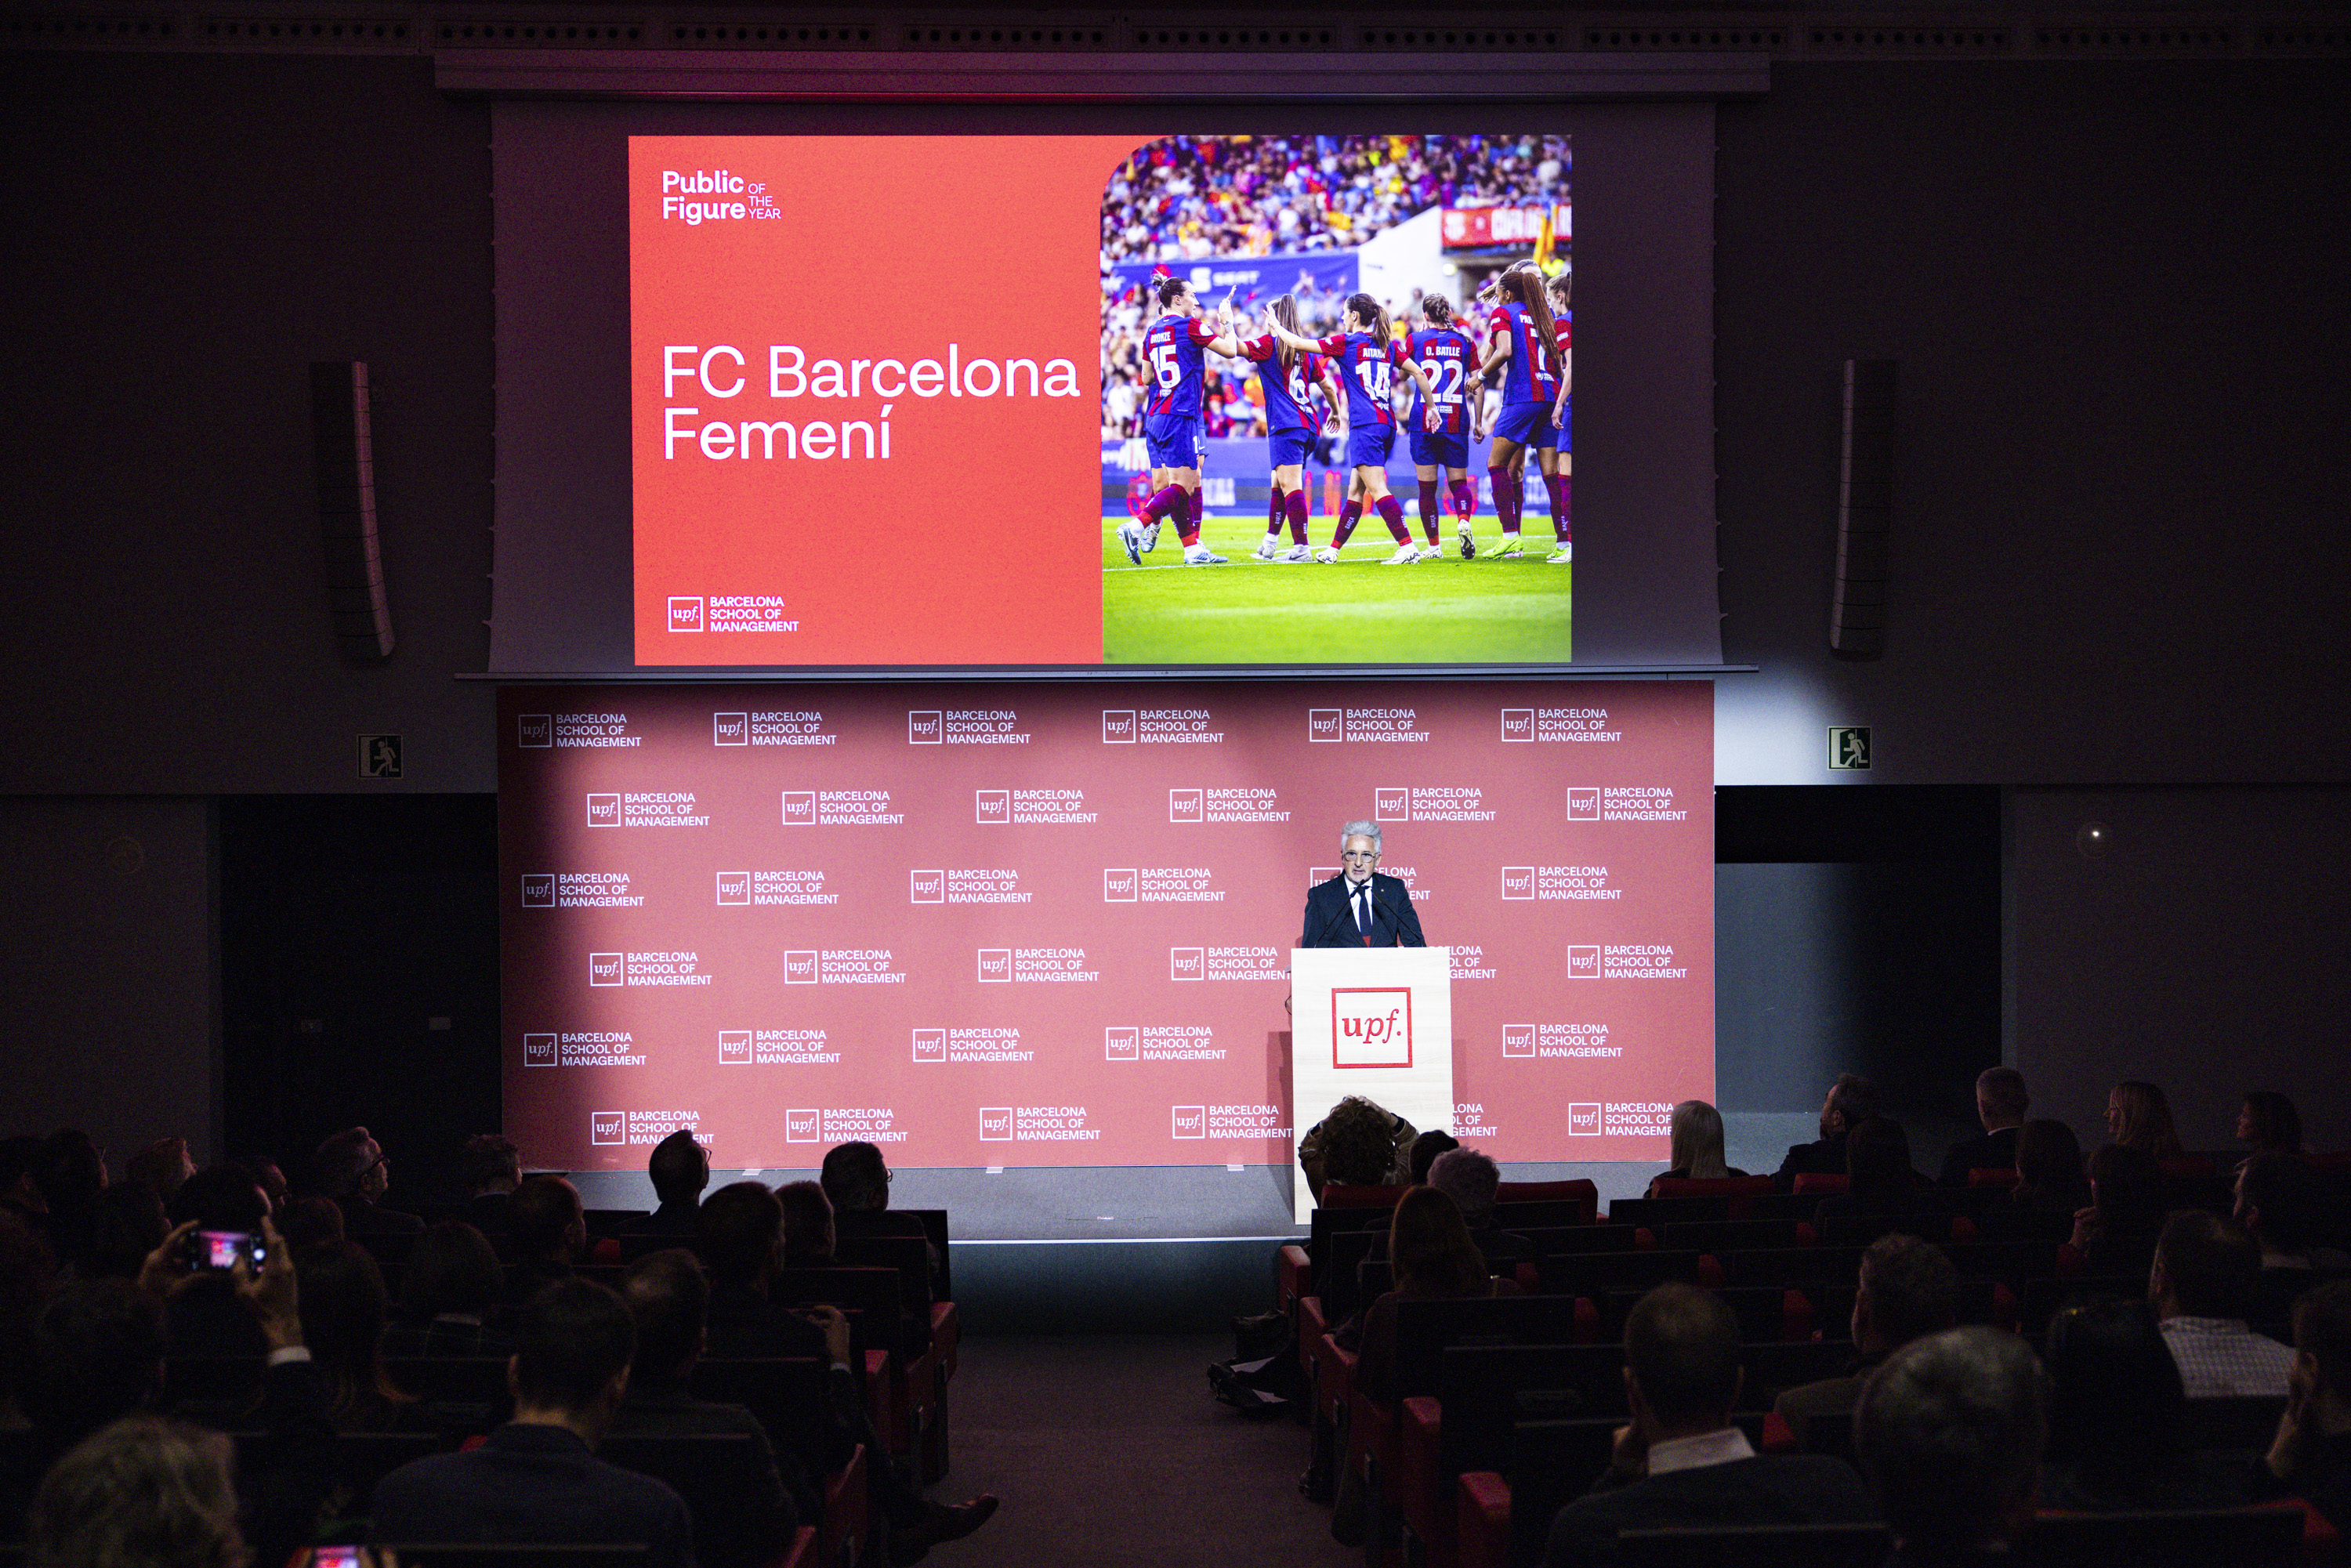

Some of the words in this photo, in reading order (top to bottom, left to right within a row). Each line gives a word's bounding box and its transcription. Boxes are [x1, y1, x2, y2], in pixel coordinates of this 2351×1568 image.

[662, 170, 744, 194] Public
[748, 183, 766, 194] OF
[748, 196, 773, 207] THE
[662, 196, 746, 226] Figure
[748, 208, 781, 219] YEAR
[1436, 346, 1461, 357] BATLLE
[664, 345, 745, 398] FC
[770, 343, 1081, 398] Barcelona
[1149, 344, 1181, 389] 15
[1289, 364, 1310, 405] 6
[1356, 360, 1391, 402] 14
[1420, 359, 1464, 404] 22
[665, 404, 893, 460] Femení
[710, 596, 784, 607] BARCELONA
[672, 606, 699, 622] upf.
[710, 609, 762, 620] SCHOOL
[765, 609, 781, 620] OF
[711, 621, 799, 632] MANAGEMENT
[556, 713, 627, 723] BARCELONA
[752, 712, 823, 722] BARCELONA
[1140, 709, 1210, 719] BARCELONA
[1346, 708, 1416, 719] BARCELONA
[1538, 708, 1608, 719] BARCELONA
[556, 725, 606, 735] SCHOOL
[609, 725, 625, 735] OF
[718, 720, 744, 736] upf.
[752, 723, 801, 733] SCHOOL
[804, 723, 820, 733] OF
[1107, 719, 1132, 734] upf.
[1140, 721, 1189, 731] SCHOOL
[1192, 721, 1208, 731] OF
[1313, 717, 1339, 733] upf.
[1346, 720, 1394, 730] SCHOOL
[1397, 720, 1413, 730] OF
[1505, 717, 1531, 733] upf.
[1538, 720, 1586, 730] SCHOOL
[1589, 720, 1605, 730] OF
[557, 737, 642, 747] MANAGEMENT
[752, 735, 837, 745] MANAGEMENT
[1140, 733, 1224, 743] MANAGEMENT
[1346, 732, 1430, 742] MANAGEMENT
[1538, 732, 1621, 741] MANAGEMENT
[625, 793, 696, 803] BARCELONA
[1014, 790, 1084, 800] BARCELONA
[1207, 788, 1277, 798] BARCELONA
[1604, 788, 1673, 797] BARCELONA
[980, 798, 1005, 814] upf.
[1014, 802, 1063, 812] SCHOOL
[1065, 802, 1081, 812] OF
[1173, 797, 1199, 813] upf.
[1207, 800, 1255, 810] SCHOOL
[1259, 800, 1274, 810] OF
[1570, 795, 1596, 811] upf.
[1604, 799, 1652, 809] SCHOOL
[1655, 799, 1671, 809] OF
[591, 802, 617, 817] upf.
[625, 804, 674, 815] SCHOOL
[677, 804, 693, 815] OF
[1604, 810, 1687, 820] MANAGEMENT
[625, 816, 710, 827] MANAGEMENT
[1014, 813, 1098, 823] MANAGEMENT
[1207, 812, 1291, 822] MANAGEMENT
[755, 871, 825, 882] BARCELONA
[1142, 868, 1212, 878] BARCELONA
[1539, 866, 1608, 876] BARCELONA
[560, 873, 630, 883] BARCELONA
[1505, 875, 1531, 890] upf.
[1538, 878, 1587, 887] SCHOOL
[1589, 878, 1605, 887] OF
[526, 882, 552, 898] upf.
[560, 885, 609, 895] SCHOOL
[611, 885, 628, 895] OF
[720, 880, 746, 896] upf.
[755, 882, 803, 893] SCHOOL
[806, 882, 822, 893] OF
[1108, 877, 1134, 893] upf.
[1142, 880, 1190, 889] SCHOOL
[1193, 880, 1208, 889] OF
[755, 894, 839, 904] MANAGEMENT
[1142, 891, 1225, 902] MANAGEMENT
[1539, 889, 1621, 900] MANAGEMENT
[560, 896, 644, 907] MANAGEMENT
[822, 950, 892, 960] BARCELONA
[1208, 947, 1278, 958] BARCELONA
[1604, 945, 1673, 955] BARCELONA
[628, 952, 698, 962] BARCELONA
[1464, 957, 1480, 968] OF
[1571, 954, 1597, 969] upf.
[1604, 957, 1652, 966] SCHOOL
[1655, 957, 1671, 966] OF
[593, 961, 619, 976] upf.
[628, 964, 676, 974] SCHOOL
[679, 964, 695, 974] OF
[788, 958, 813, 974] upf.
[822, 961, 871, 972] SCHOOL
[874, 961, 889, 972] OF
[1175, 956, 1201, 972] upf.
[1208, 958, 1256, 969] SCHOOL
[1259, 958, 1275, 969] OF
[822, 973, 906, 983] MANAGEMENT
[1450, 969, 1497, 980] GEMENT
[1605, 969, 1687, 978] MANAGEMENT
[628, 975, 712, 986] MANAGEMENT
[1342, 1008, 1402, 1044] upf.
[1540, 1024, 1609, 1034] BARCELONA
[562, 1032, 632, 1042] BARCELONA
[950, 1028, 1020, 1038] BARCELONA
[916, 1037, 942, 1052] upf.
[950, 1040, 998, 1050] SCHOOL
[1002, 1040, 1017, 1050] OF
[1506, 1033, 1532, 1048] upf.
[1539, 1036, 1588, 1045] SCHOOL
[1590, 1036, 1606, 1045] OF
[528, 1041, 554, 1057] upf.
[562, 1044, 610, 1055] SCHOOL
[614, 1044, 629, 1055] OF
[1540, 1047, 1623, 1057] MANAGEMENT
[562, 1056, 647, 1066] MANAGEMENT
[951, 1051, 1034, 1062] MANAGEMENT
[1209, 1105, 1278, 1115] BARCELONA
[1606, 1103, 1674, 1113] BARCELONA
[629, 1110, 700, 1121] BARCELONA
[824, 1109, 894, 1119] BARCELONA
[1465, 1114, 1481, 1125] OF
[1572, 1111, 1598, 1127] upf.
[1605, 1114, 1654, 1124] SCHOOL
[1656, 1114, 1671, 1124] OF
[596, 1120, 621, 1135] upf.
[629, 1122, 678, 1133] SCHOOL
[681, 1122, 697, 1133] OF
[790, 1117, 816, 1133] upf.
[824, 1120, 872, 1131] SCHOOL
[875, 1120, 891, 1131] OF
[1176, 1114, 1202, 1130] upf.
[1209, 1117, 1258, 1127] SCHOOL
[1260, 1117, 1276, 1127] OF
[824, 1132, 908, 1143] MANAGEMENT
[1209, 1128, 1292, 1139] MANAGEMENT
